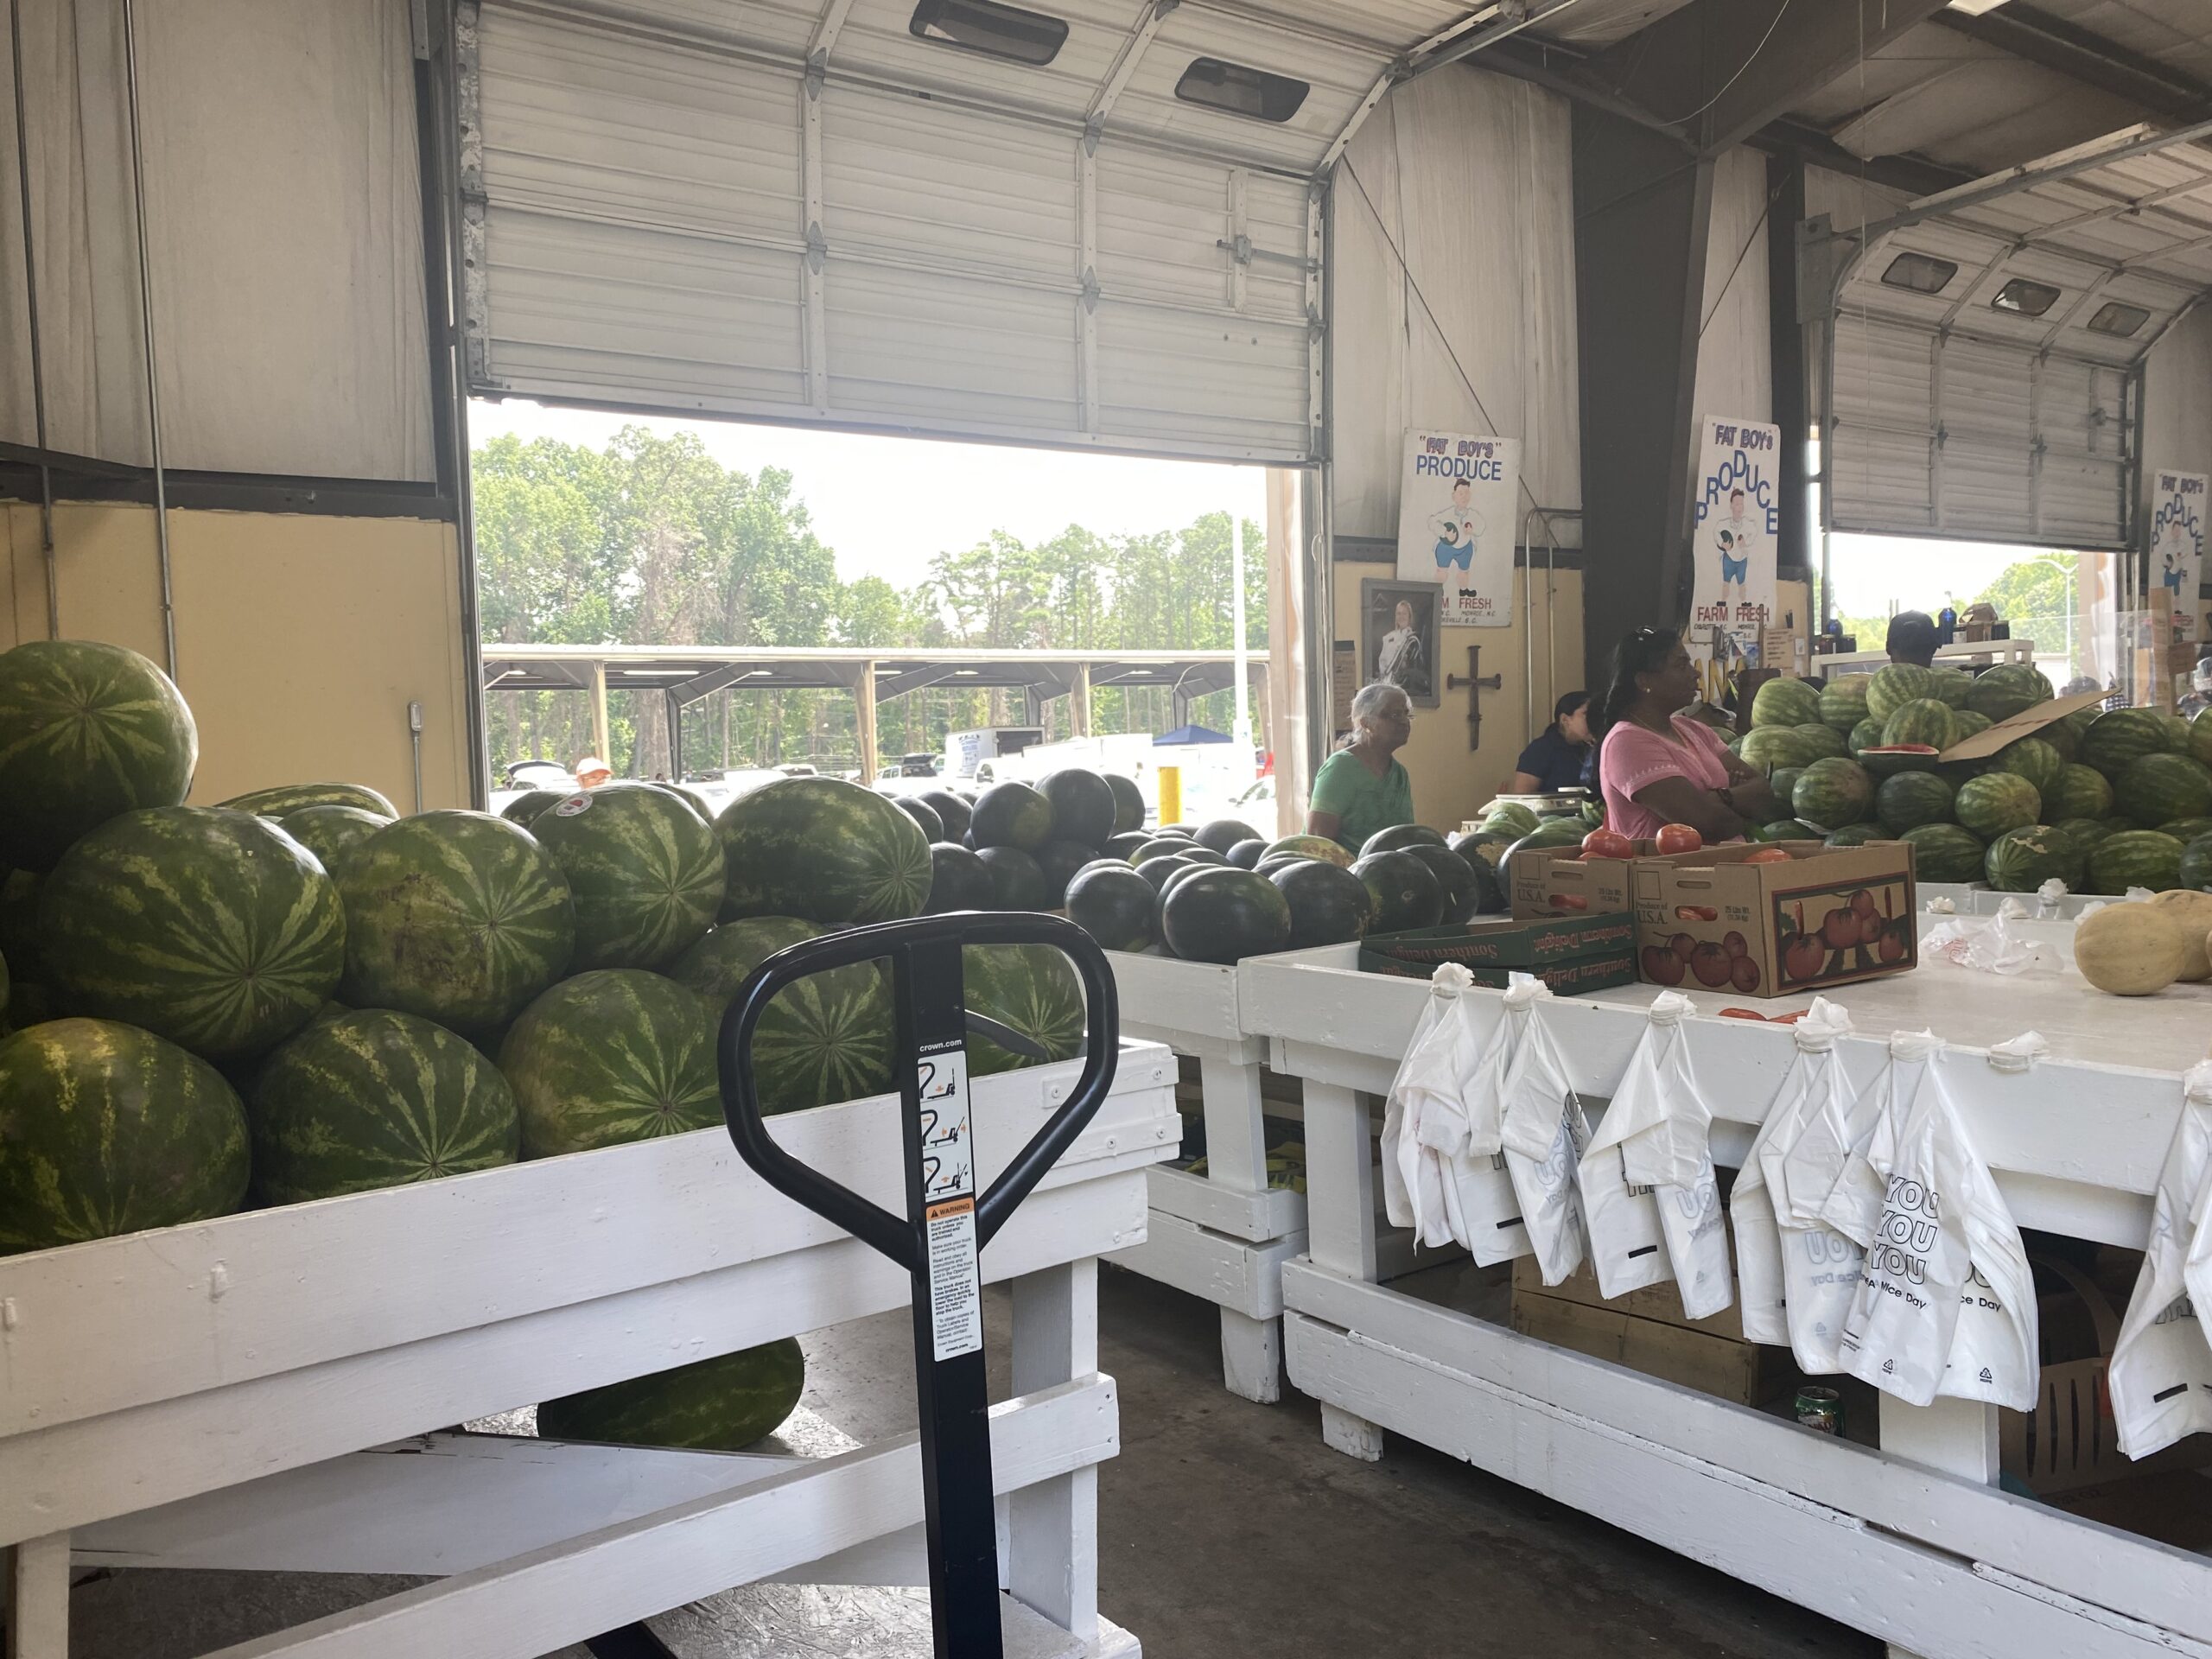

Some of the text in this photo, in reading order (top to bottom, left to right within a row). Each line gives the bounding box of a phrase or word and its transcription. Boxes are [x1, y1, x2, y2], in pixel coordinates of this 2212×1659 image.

[1417, 454, 1503, 480] PRODUCE
[1694, 450, 1778, 534] PRODUCE
[2152, 493, 2204, 556] PRODUCE
[1459, 597, 1491, 609] FRESH
[1697, 607, 1770, 622] FARM FRESH
[1517, 889, 1546, 904] U.S.A.
[1637, 910, 1669, 925] U.S.A.
[1580, 957, 1631, 977] Southern
[919, 1039, 963, 1052] crown.com
[1885, 1173, 1940, 1219] YOU
[939, 1203, 970, 1215] WARNING
[1877, 1210, 1938, 1253] YOU
[1871, 1240, 1927, 1286] YOU
[1905, 1293, 1927, 1309] Day
[1979, 1297, 2001, 1312] Day
